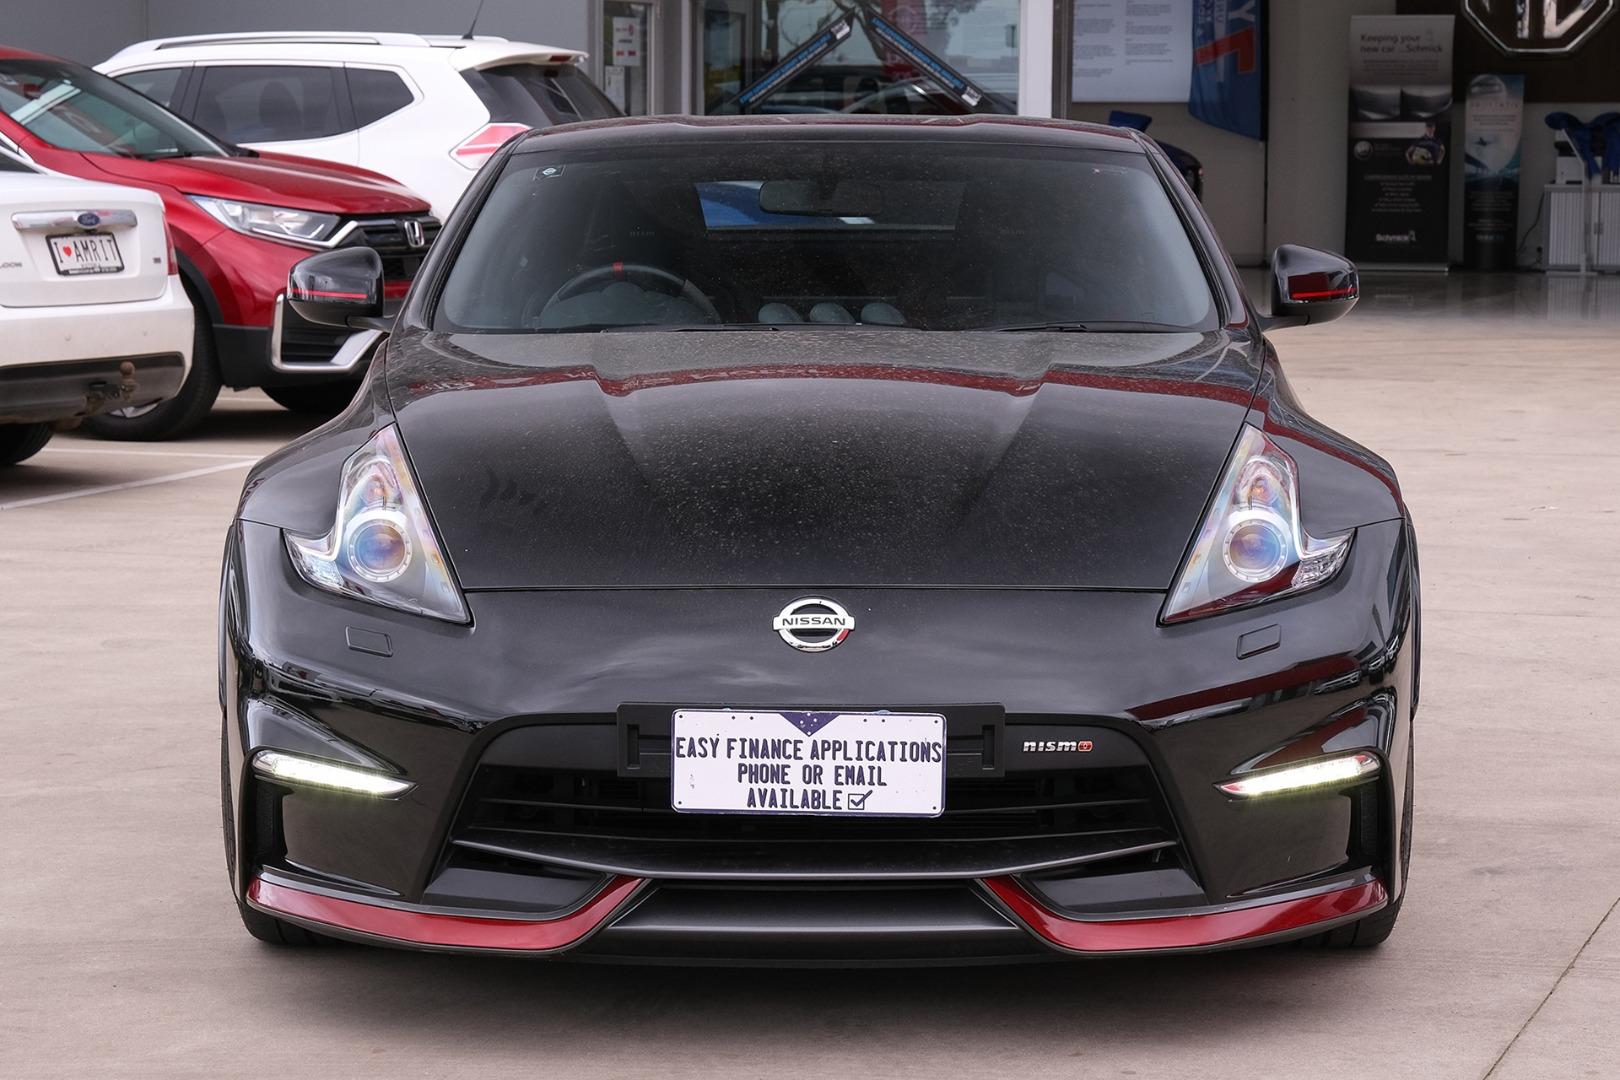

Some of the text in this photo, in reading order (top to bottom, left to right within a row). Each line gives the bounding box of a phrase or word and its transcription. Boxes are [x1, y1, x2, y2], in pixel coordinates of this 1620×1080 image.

[1360, 33, 1420, 44] Keeping your
[73, 239, 117, 262] AMRIT
[782, 617, 846, 626] NISSAN
[676, 737, 942, 763] EASY FINANCE APPLICATIONS
[737, 763, 888, 787] PHONE OR EMAIL
[746, 787, 843, 810] AVAILABLE
